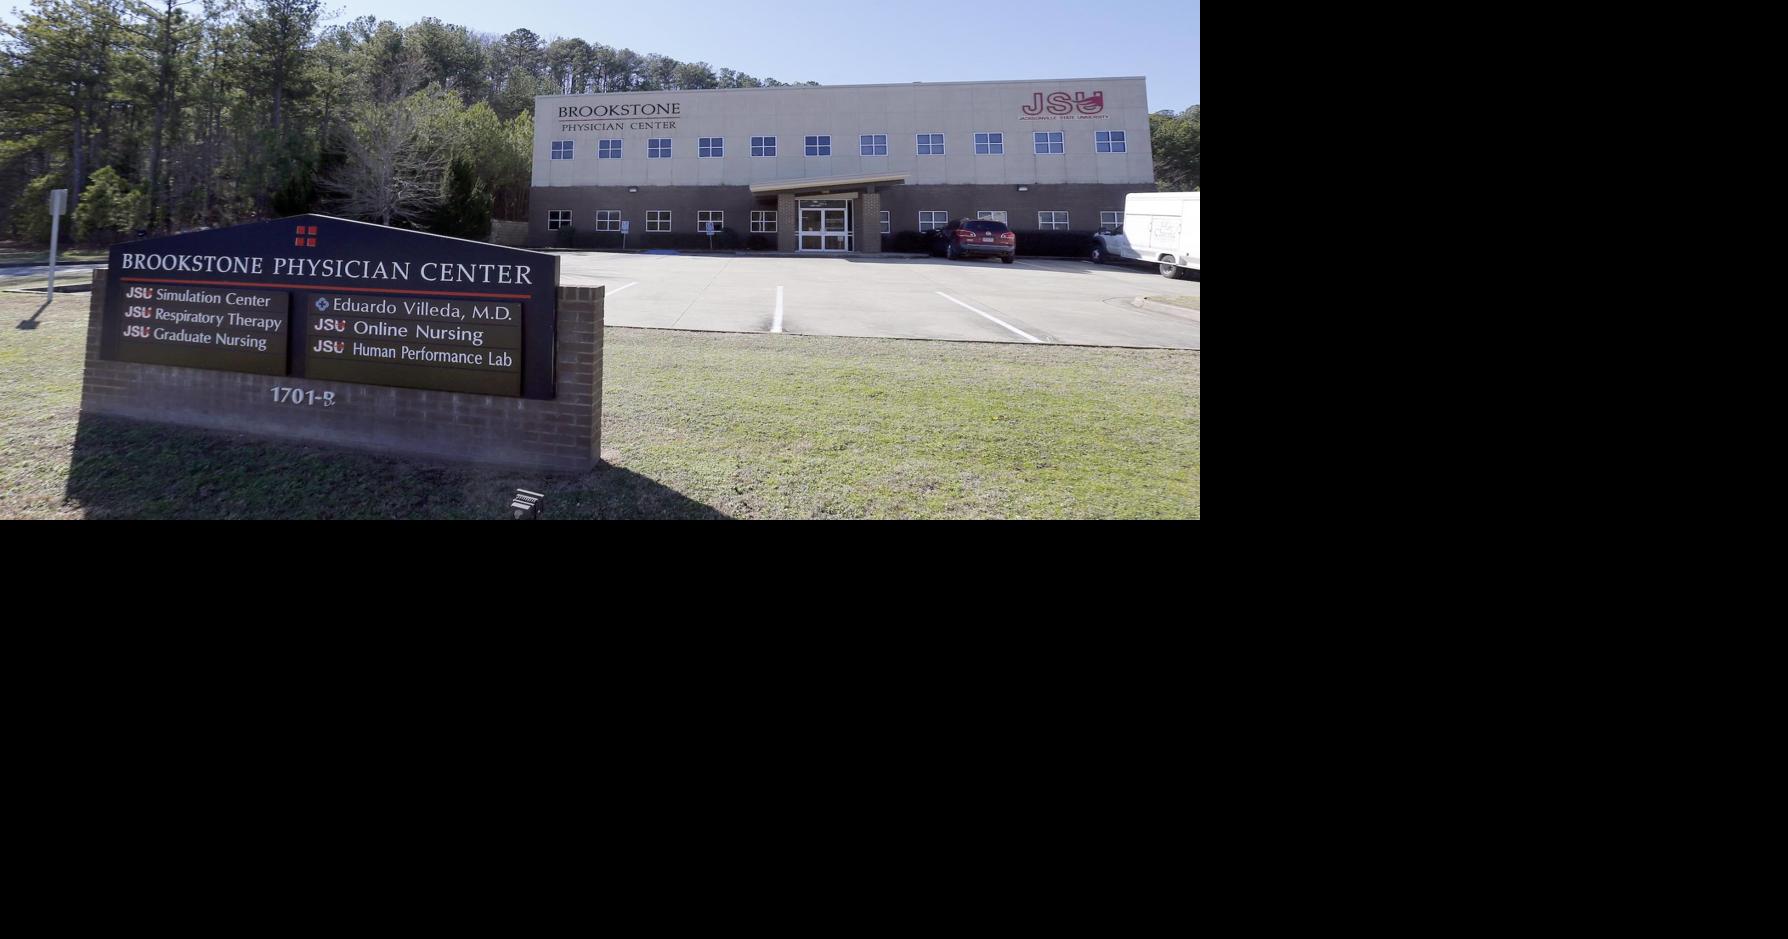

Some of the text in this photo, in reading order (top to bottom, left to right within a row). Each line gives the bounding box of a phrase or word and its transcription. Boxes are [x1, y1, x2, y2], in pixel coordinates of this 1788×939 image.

[558, 102, 681, 118] BROOKSTONE
[1022, 91, 1104, 115] JSU
[561, 121, 676, 132] PHYSICIAN CENTER
[122, 253, 533, 285] BROOKSTONE PHYSICIAN CENTER
[125, 286, 271, 307] JSU Simulation Center
[124, 305, 282, 332] JSU Respiratory Therapy
[333, 298, 512, 321] Eduardo Villeda, M.D.
[123, 325, 267, 351] JSU Graduate Nursing
[314, 318, 484, 346] JSU Online Nursing
[313, 340, 512, 367] JSU Human Performance Lab
